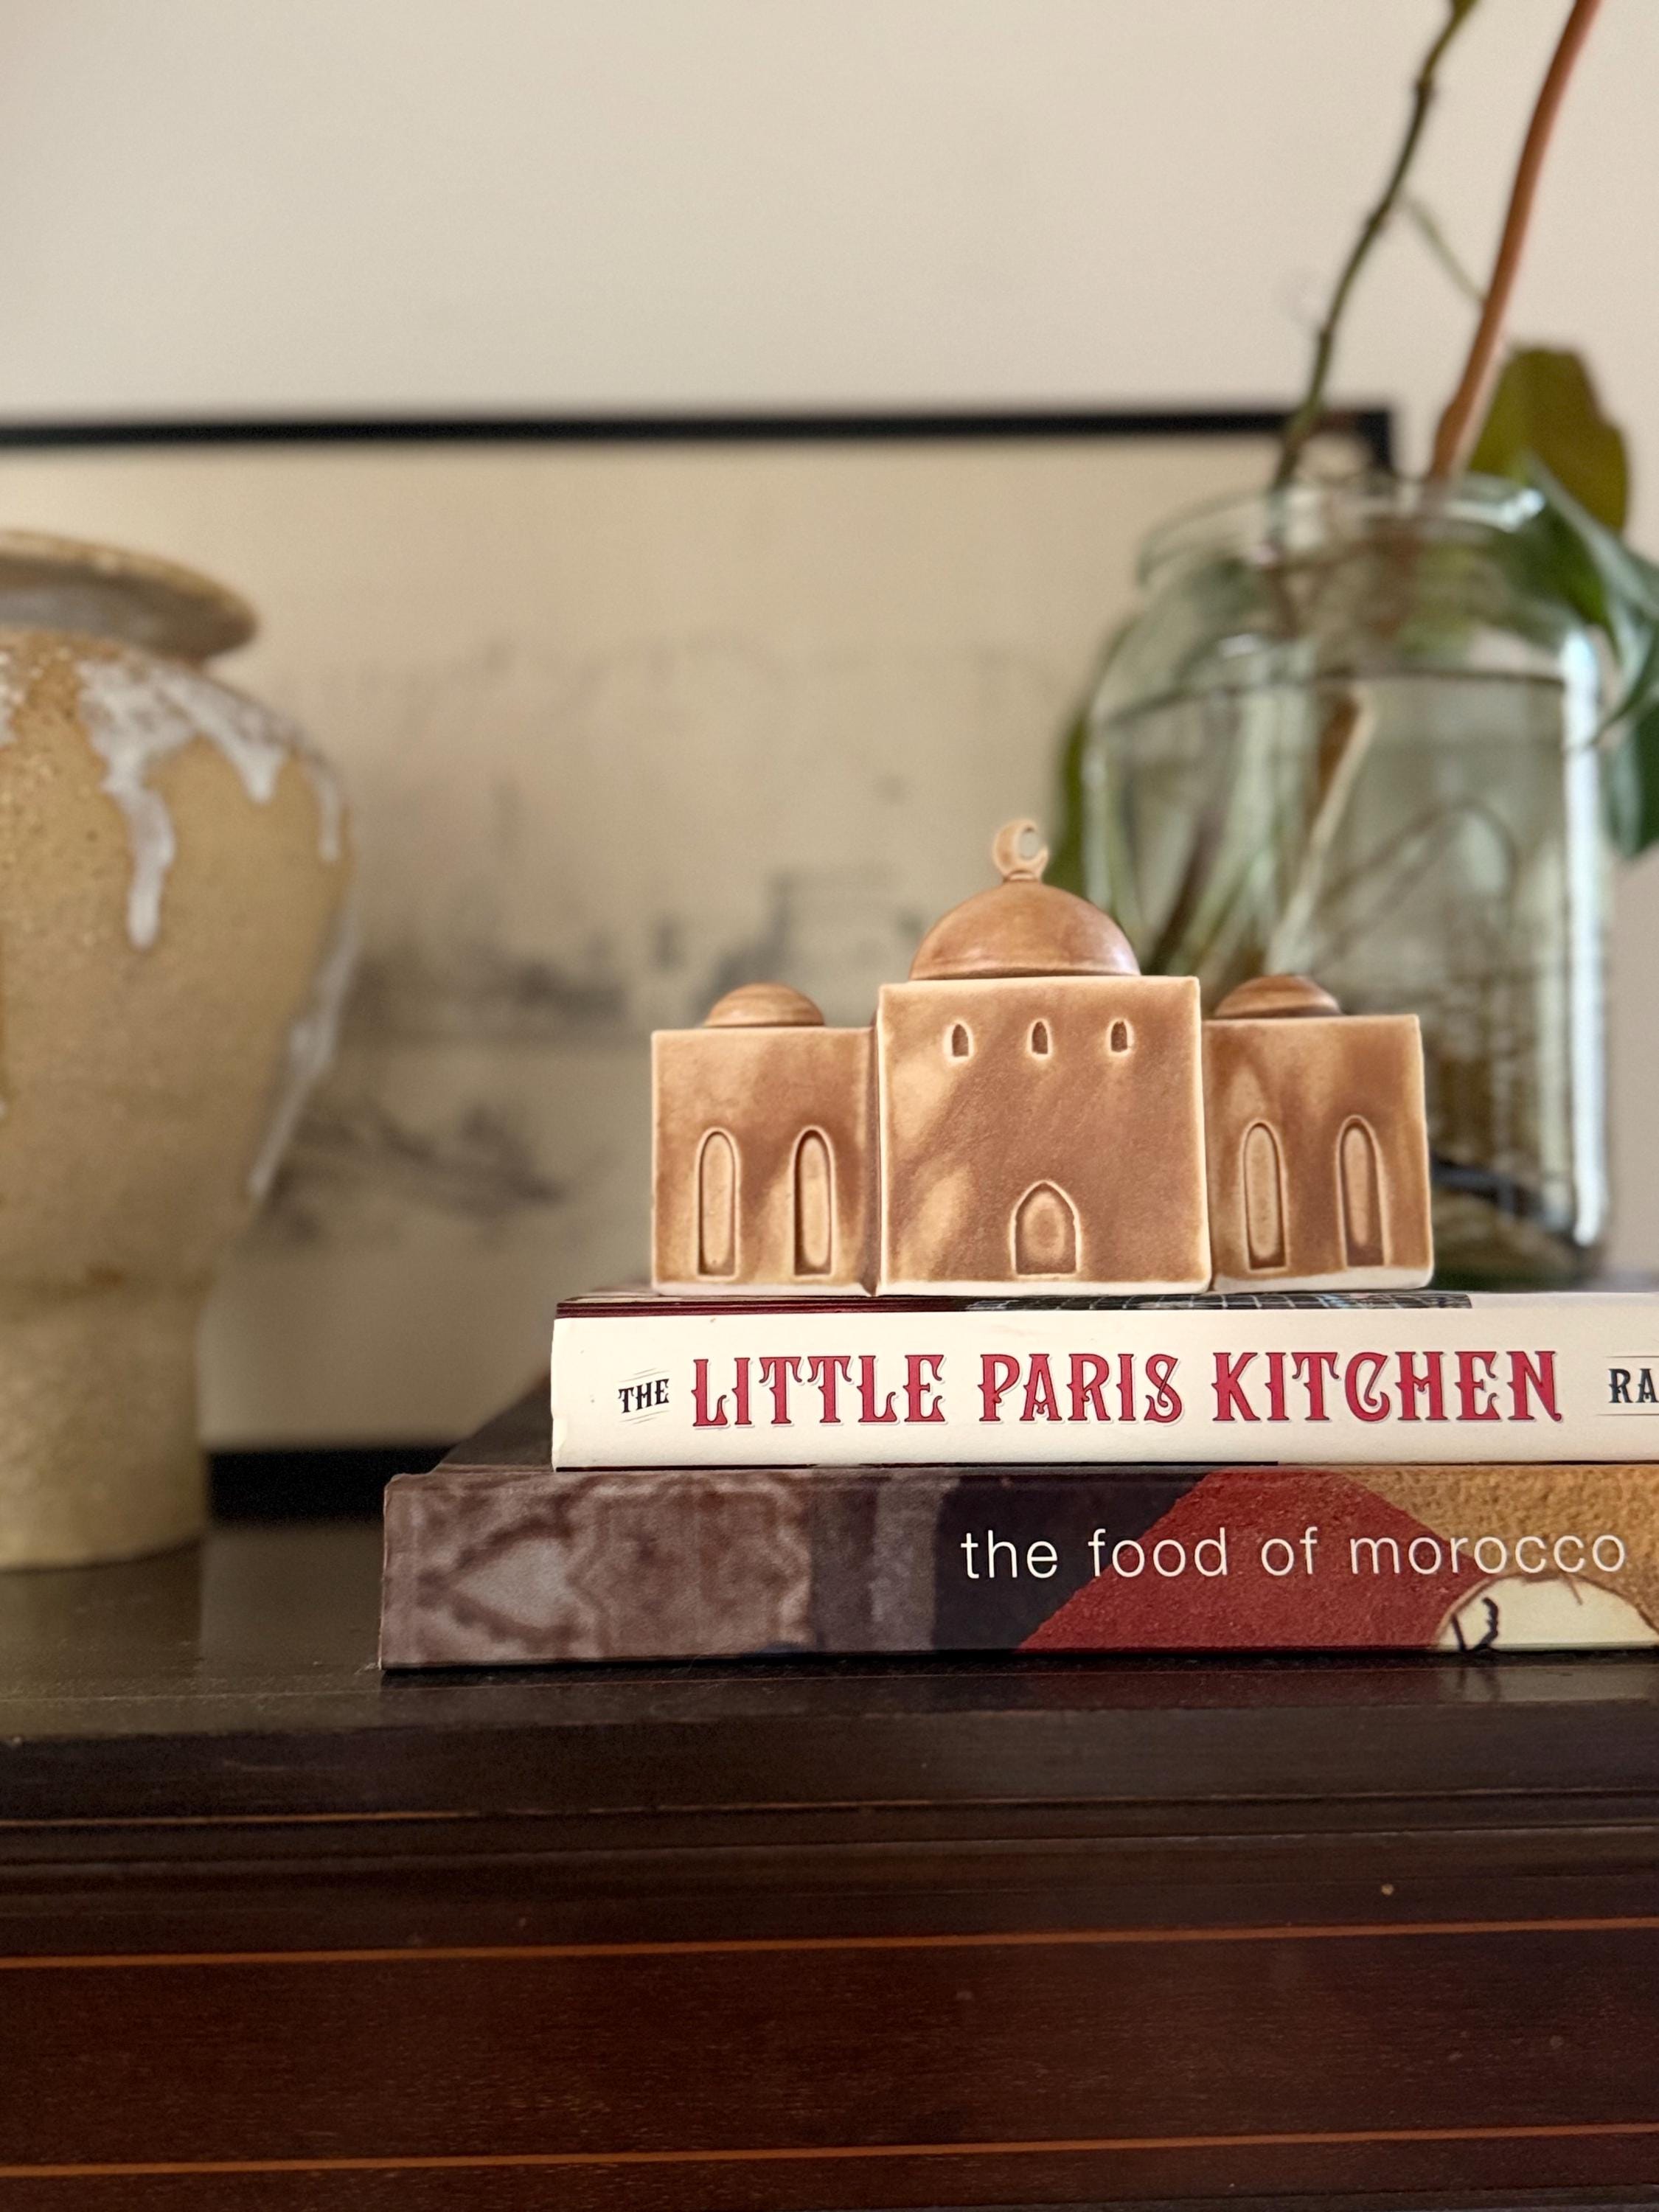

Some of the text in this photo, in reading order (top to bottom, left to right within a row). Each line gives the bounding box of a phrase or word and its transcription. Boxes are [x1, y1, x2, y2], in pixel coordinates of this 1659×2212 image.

[618, 1351, 1562, 1427] THE LITTLE PARIS KITCHEN
[1608, 1367, 1659, 1404] RA
[960, 1526, 1626, 1579] the food of morocco
